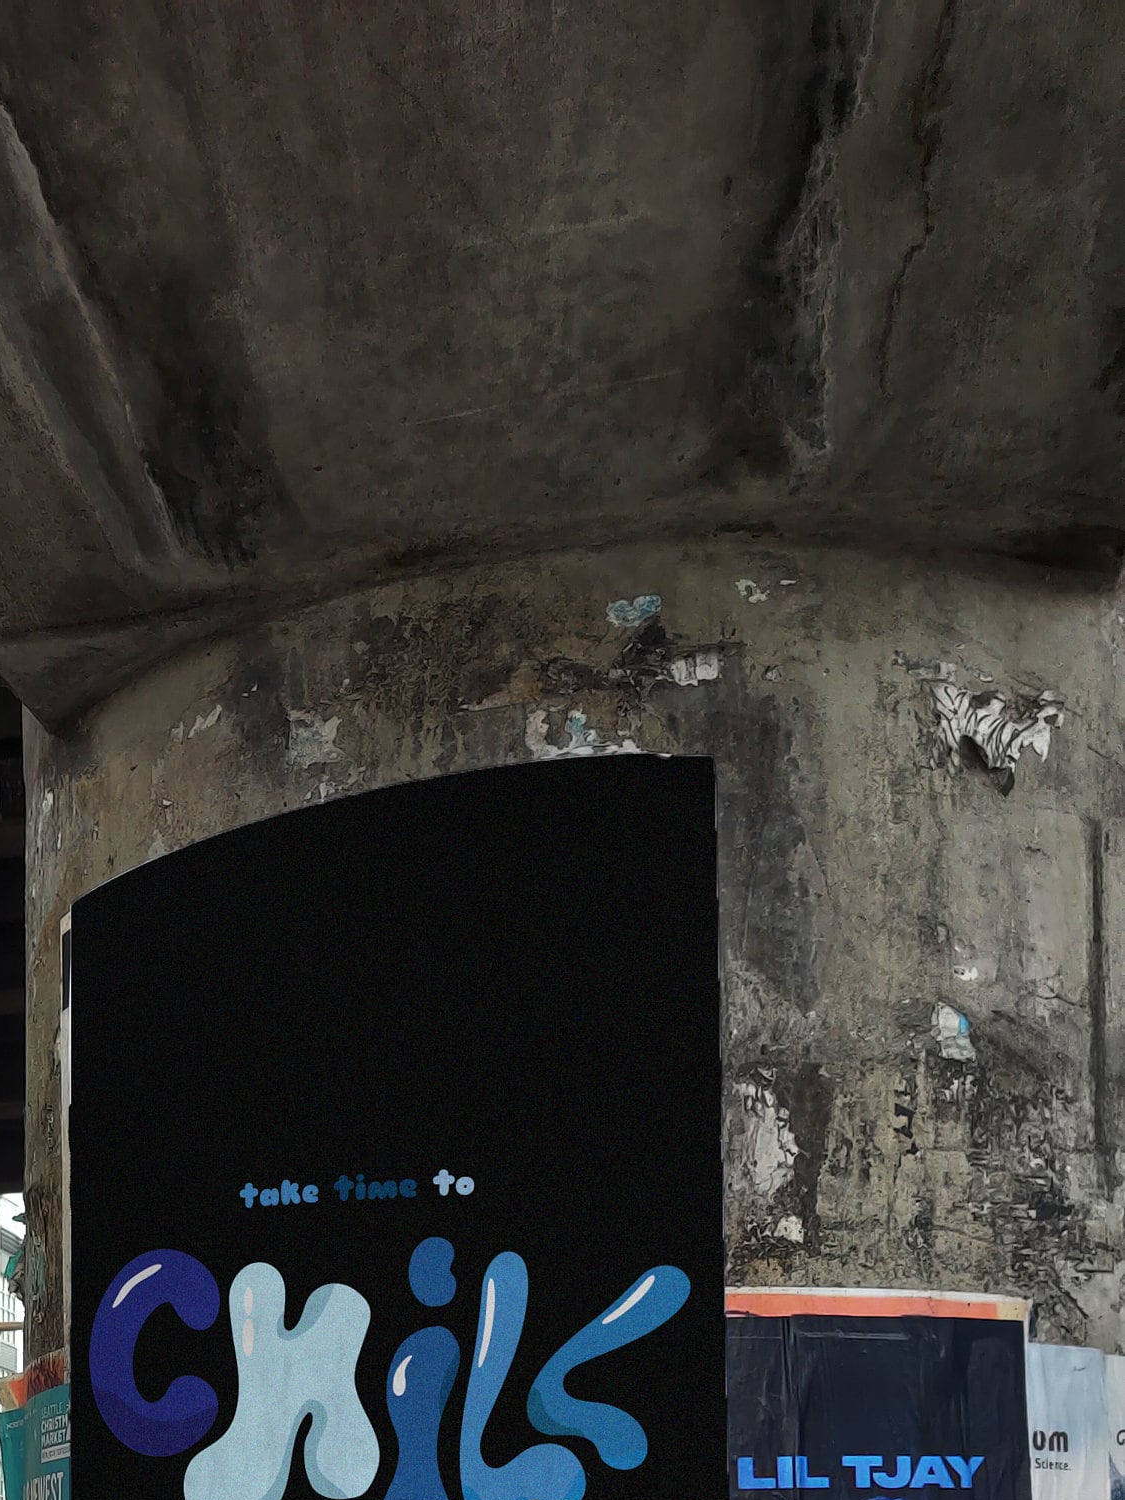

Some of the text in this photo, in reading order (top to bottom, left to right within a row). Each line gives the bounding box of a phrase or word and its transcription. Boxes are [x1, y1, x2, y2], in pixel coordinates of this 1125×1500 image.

[240, 1169, 475, 1208] take time to
[737, 1454, 985, 1490] LIL TJAY
